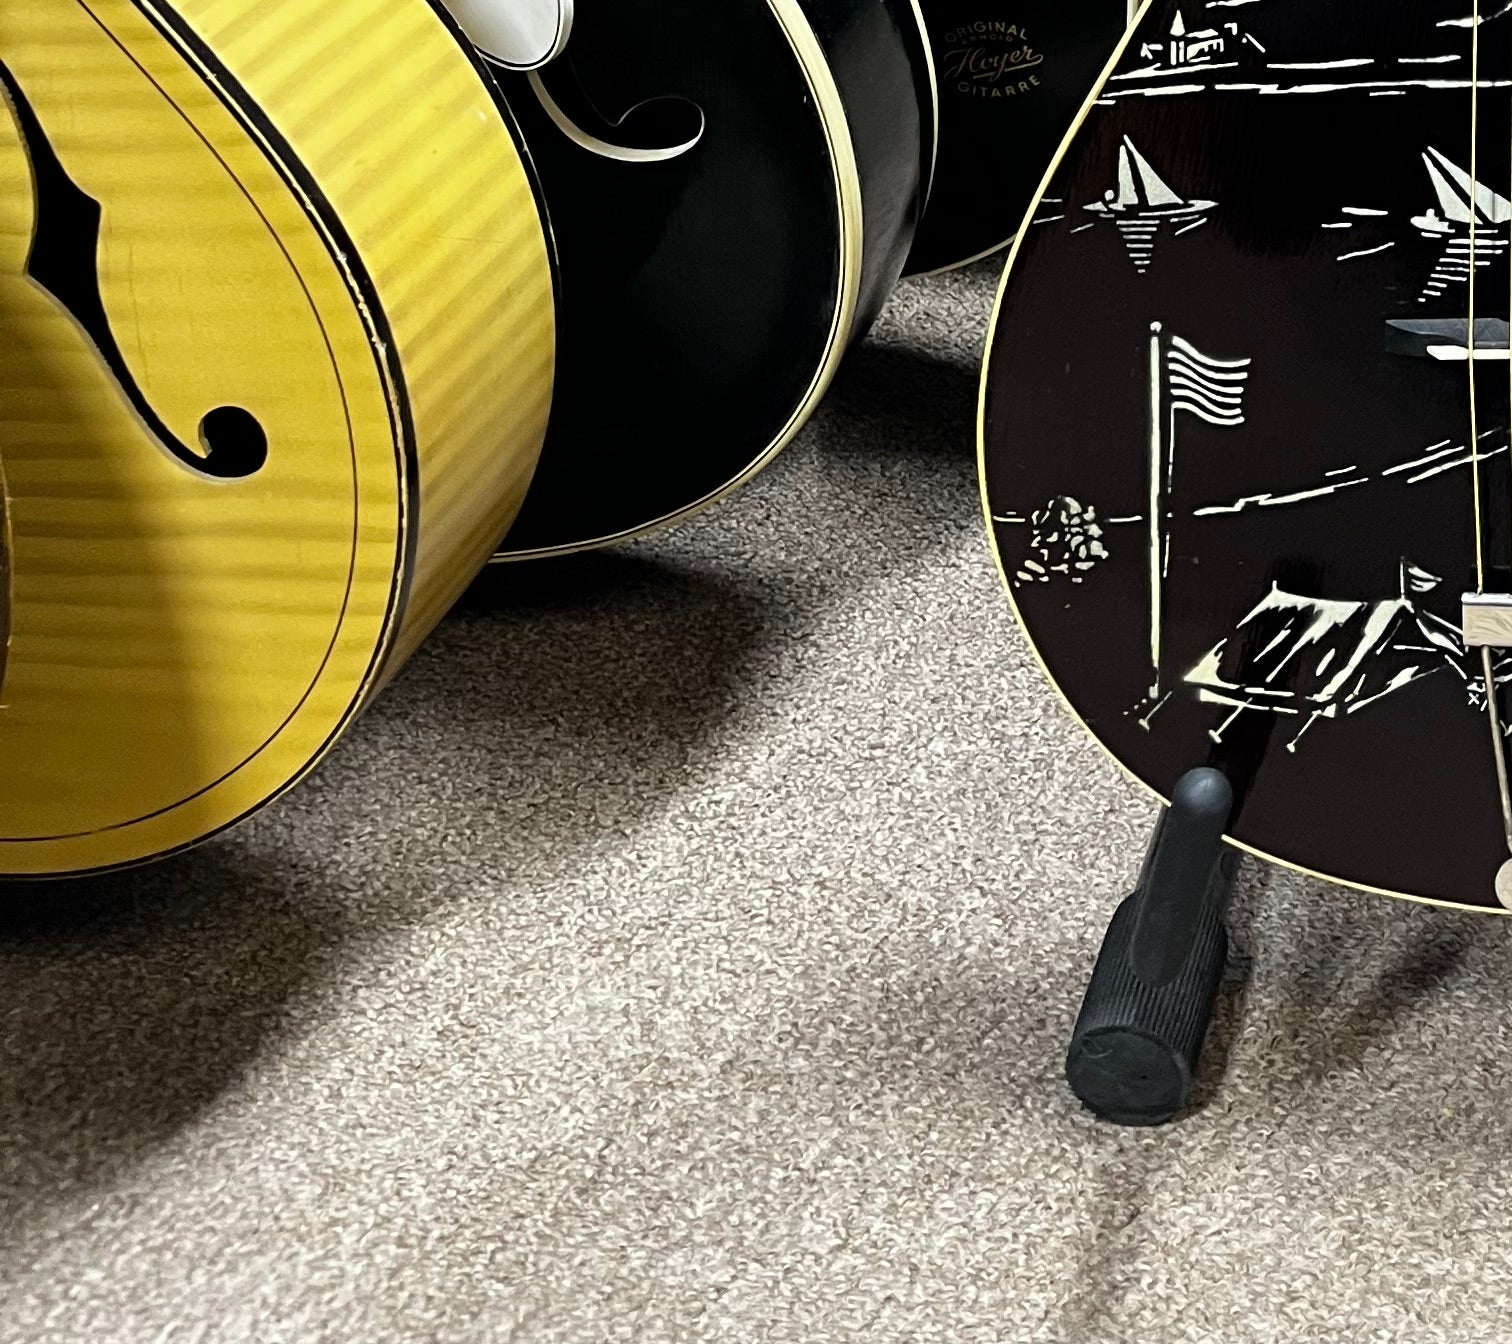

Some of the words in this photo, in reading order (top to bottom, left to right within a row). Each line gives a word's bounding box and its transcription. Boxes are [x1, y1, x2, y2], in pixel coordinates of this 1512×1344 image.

[945, 21, 1028, 44] ORIGINAL
[944, 45, 1044, 82] Hoyer
[957, 74, 1042, 98] GITARRE
